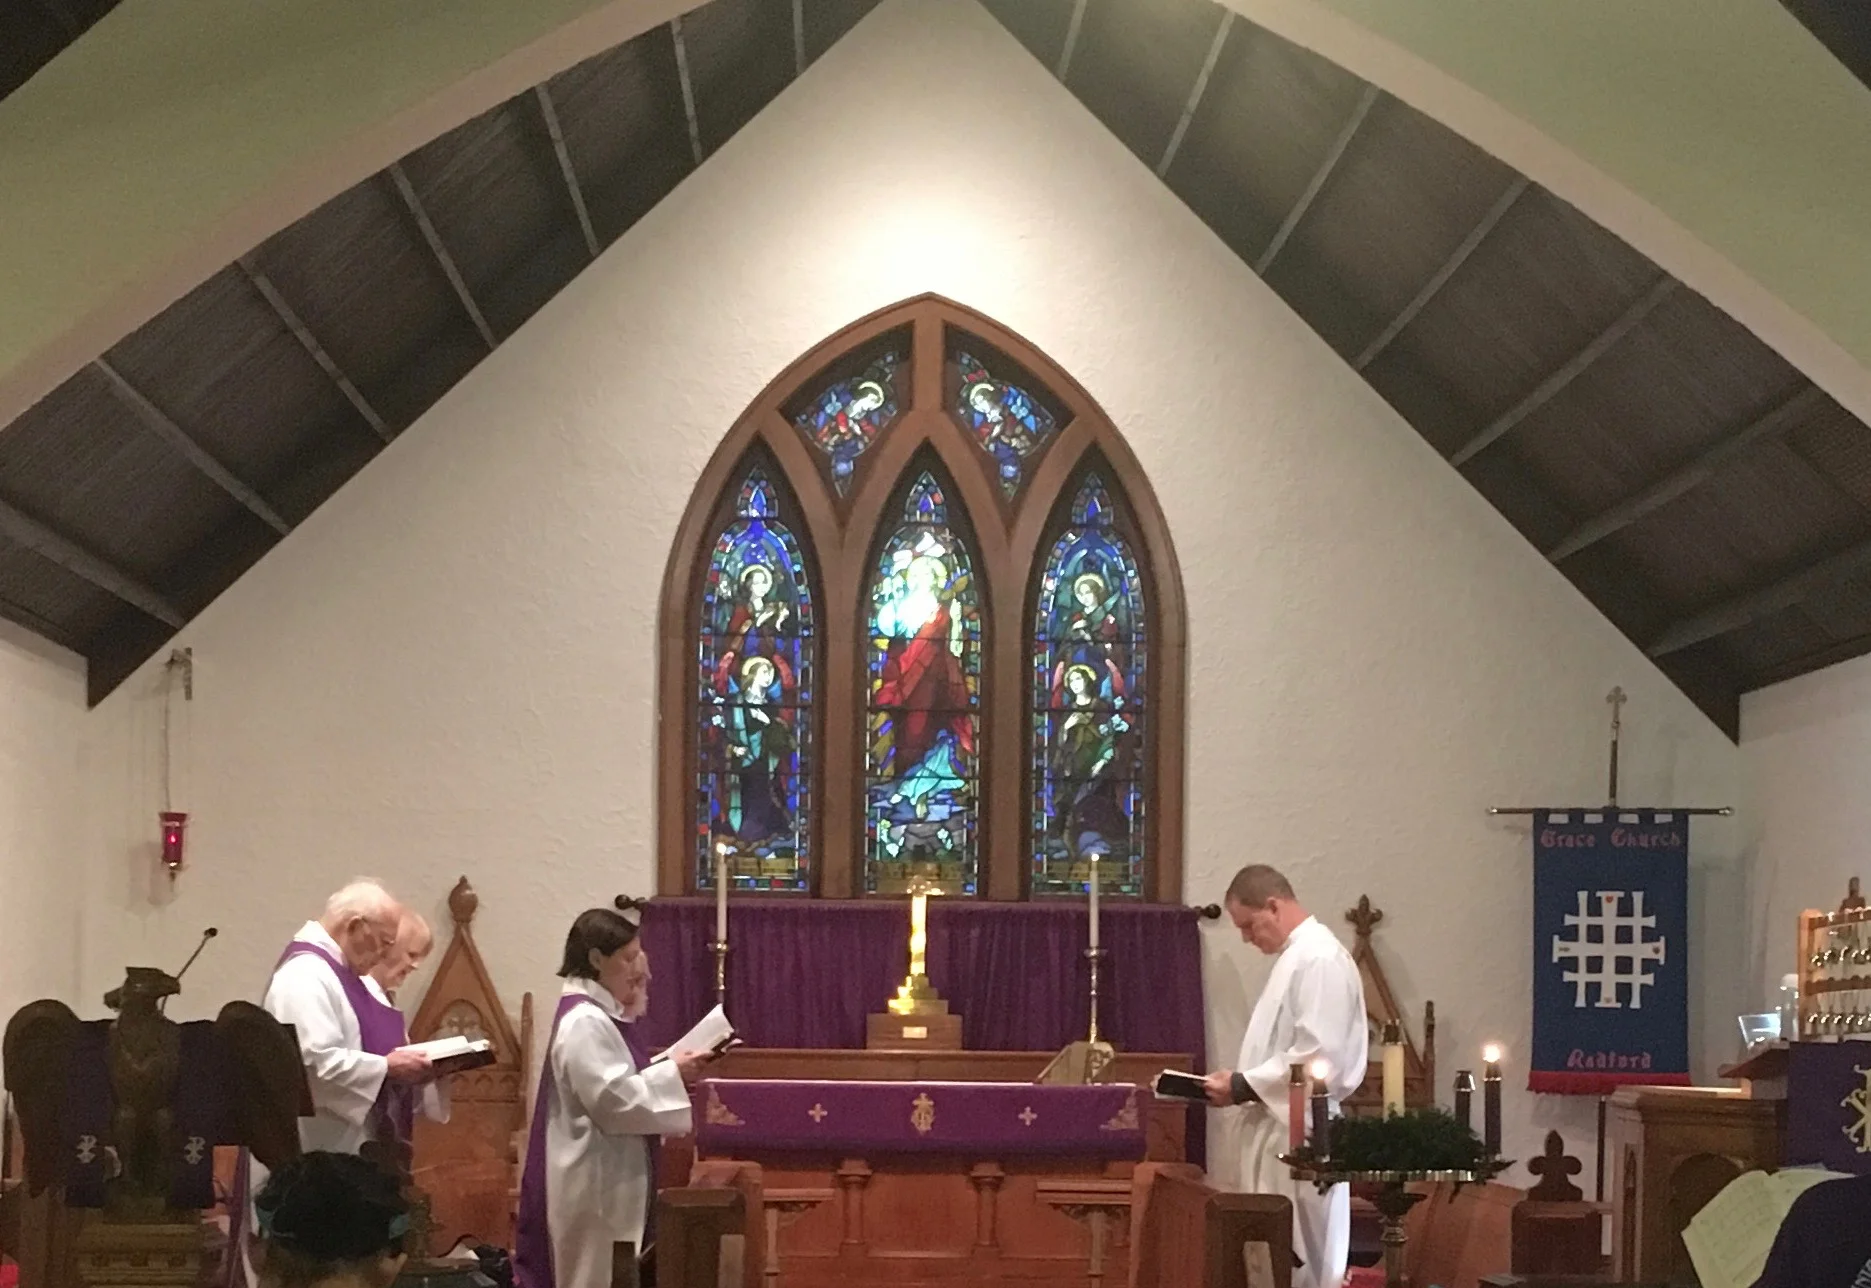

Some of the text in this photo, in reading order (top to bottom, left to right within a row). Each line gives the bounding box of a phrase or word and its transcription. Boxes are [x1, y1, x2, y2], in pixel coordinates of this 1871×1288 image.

[1541, 828, 1681, 847] Grace Church
[1567, 1049, 1651, 1068] Radford
